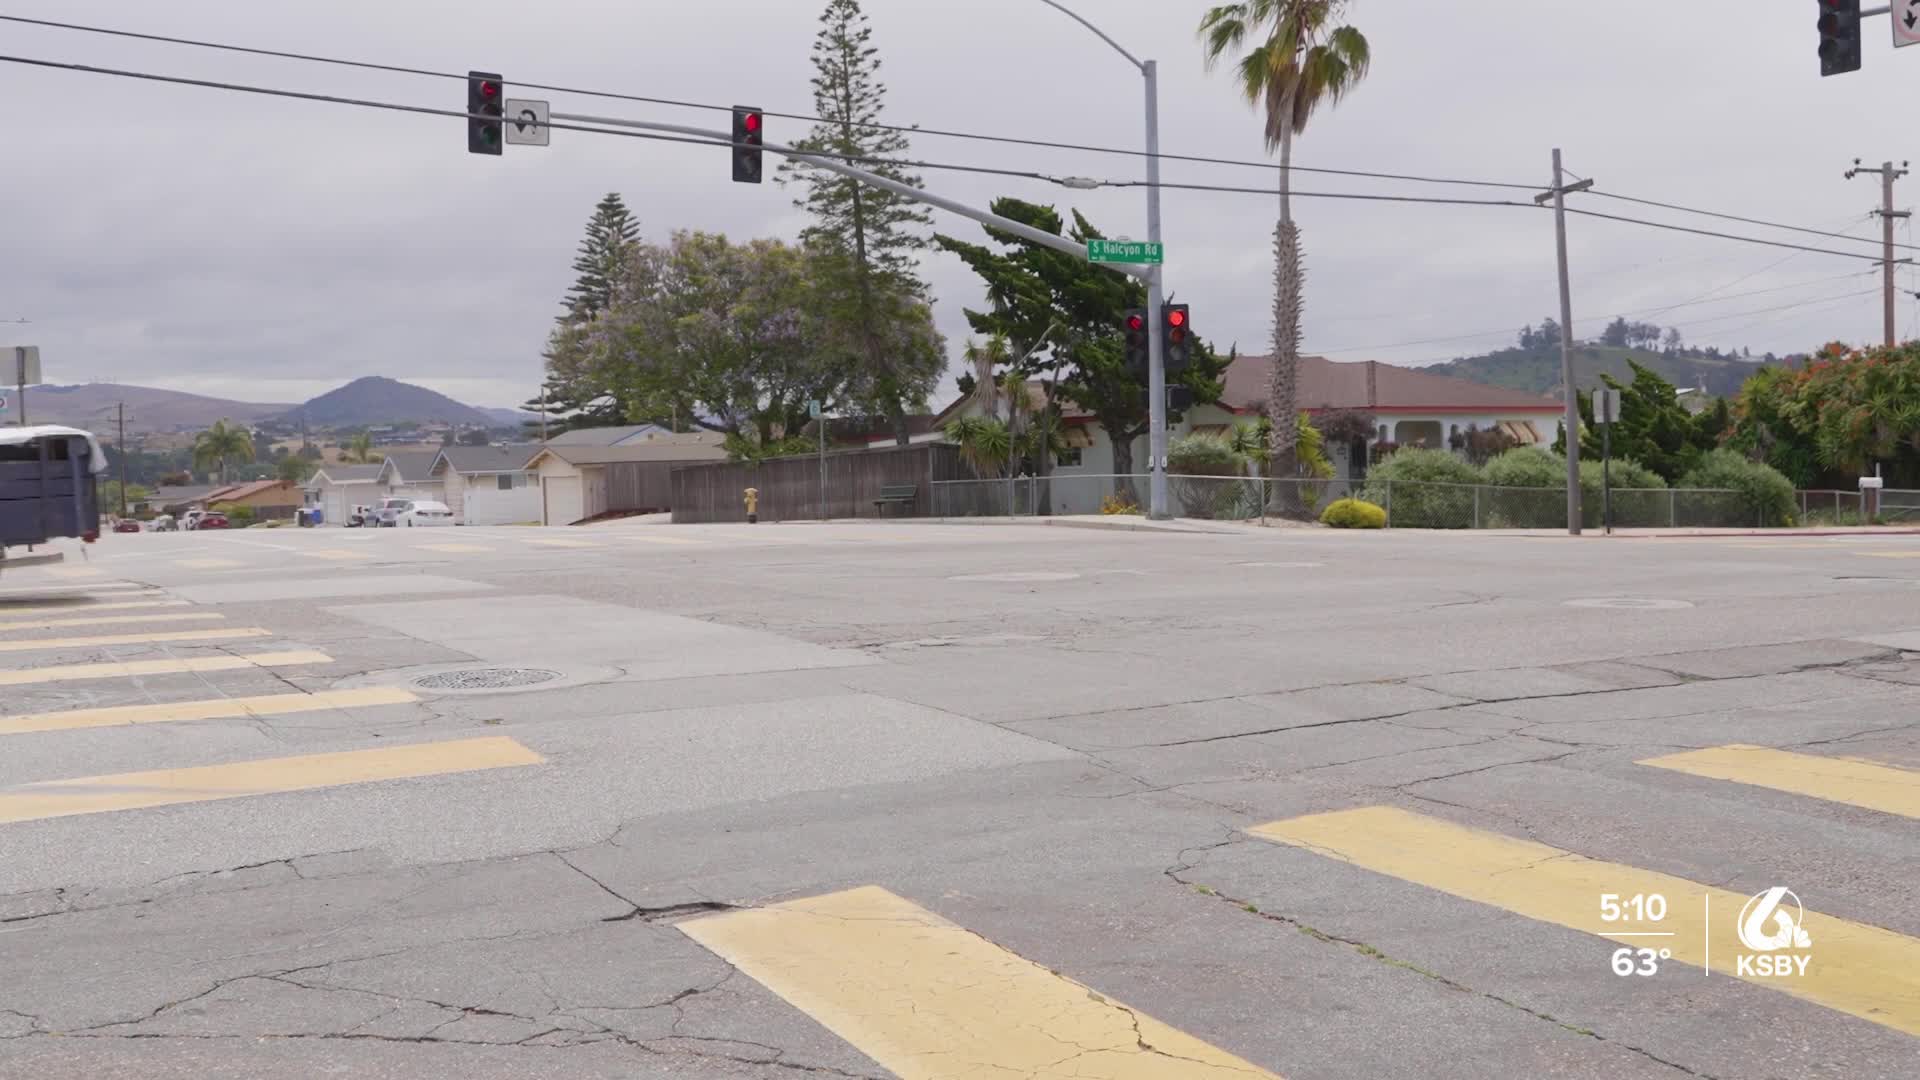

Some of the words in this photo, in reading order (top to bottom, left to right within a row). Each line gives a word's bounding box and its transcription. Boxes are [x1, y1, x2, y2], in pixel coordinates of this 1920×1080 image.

[1093, 241, 1099, 254] S
[1103, 242, 1140, 256] Halcyon
[1145, 244, 1157, 256] Rd
